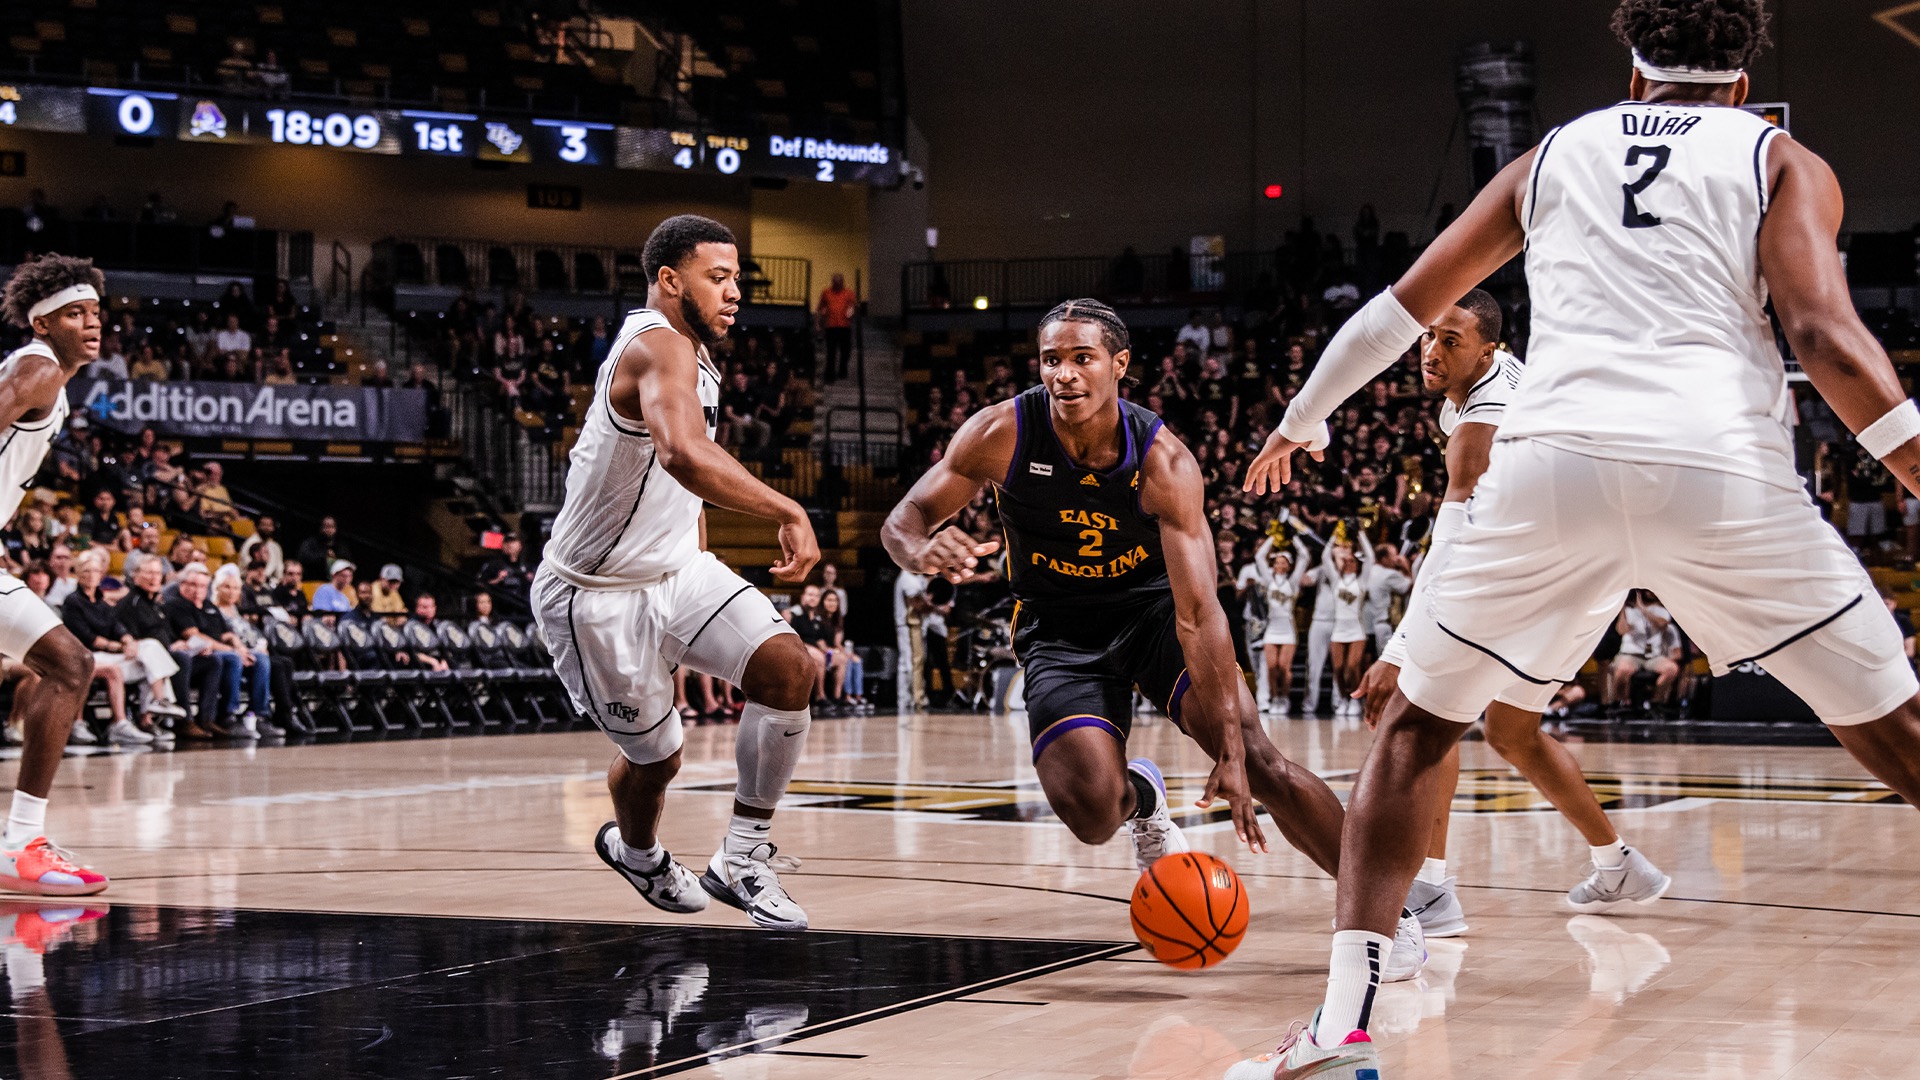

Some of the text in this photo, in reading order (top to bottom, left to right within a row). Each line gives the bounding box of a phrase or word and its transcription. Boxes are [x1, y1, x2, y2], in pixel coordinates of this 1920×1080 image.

[118, 95, 154, 134] 0
[266, 109, 381, 149] 18:09
[1621, 113, 1702, 137] DURR
[413, 121, 463, 152] 1st
[558, 126, 588, 162] 3
[770, 135, 889, 165] Def Rebounds
[673, 147, 694, 169] 4
[716, 147, 741, 175] 0
[815, 159, 835, 182] 2
[1621, 143, 1672, 229] 2
[245, 386, 357, 428] Arena
[1059, 509, 1120, 531] EAST
[1078, 529, 1103, 557] 2
[1031, 545, 1149, 578] CAROLINA
